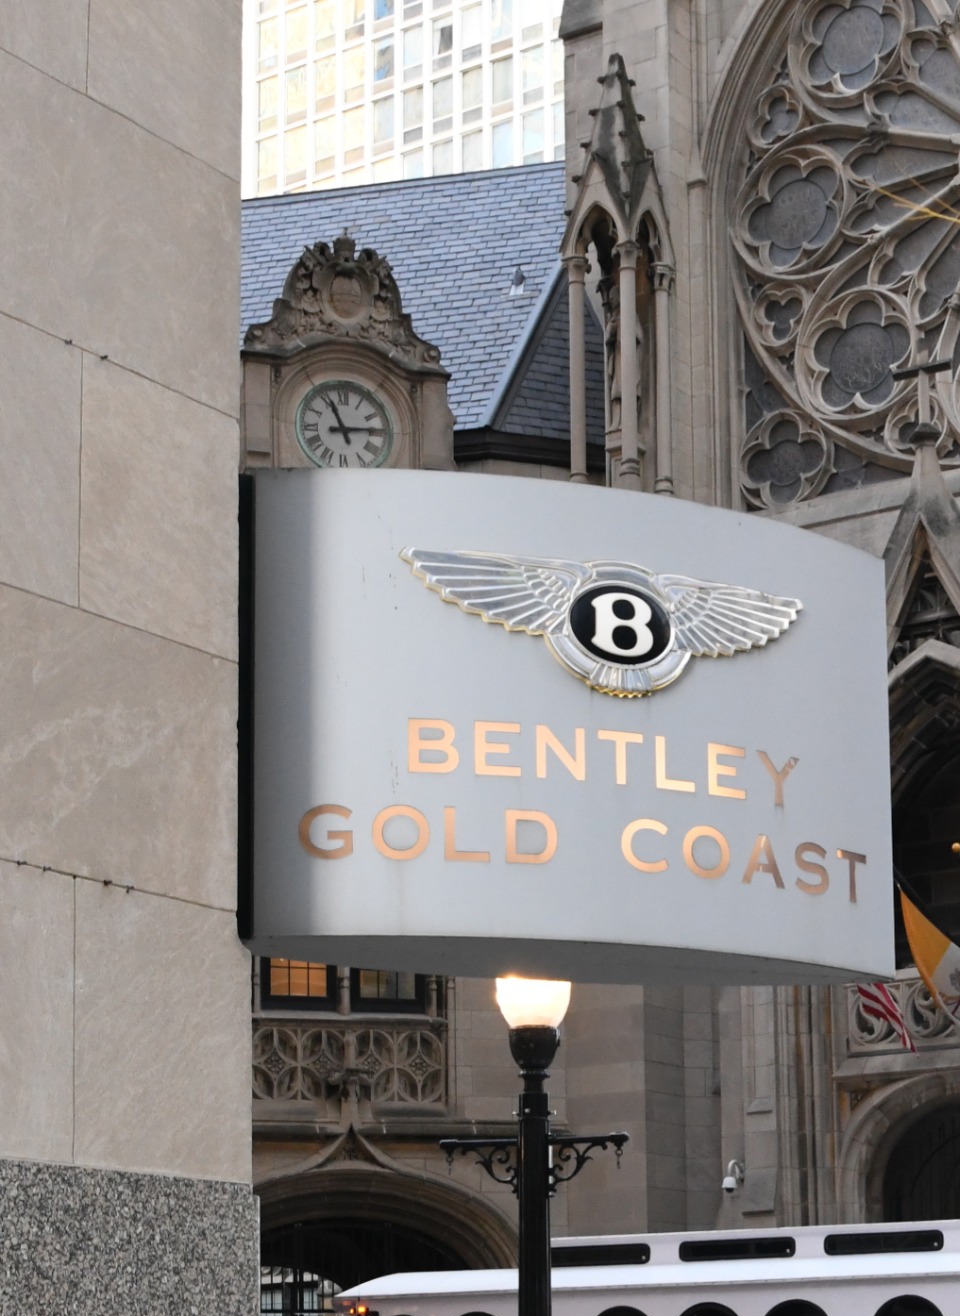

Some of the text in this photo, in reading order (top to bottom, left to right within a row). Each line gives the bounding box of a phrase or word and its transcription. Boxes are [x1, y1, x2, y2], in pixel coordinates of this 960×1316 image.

[591, 592, 653, 656] B
[407, 717, 800, 806] BENTLEY
[298, 804, 867, 904] GOLD COAST
